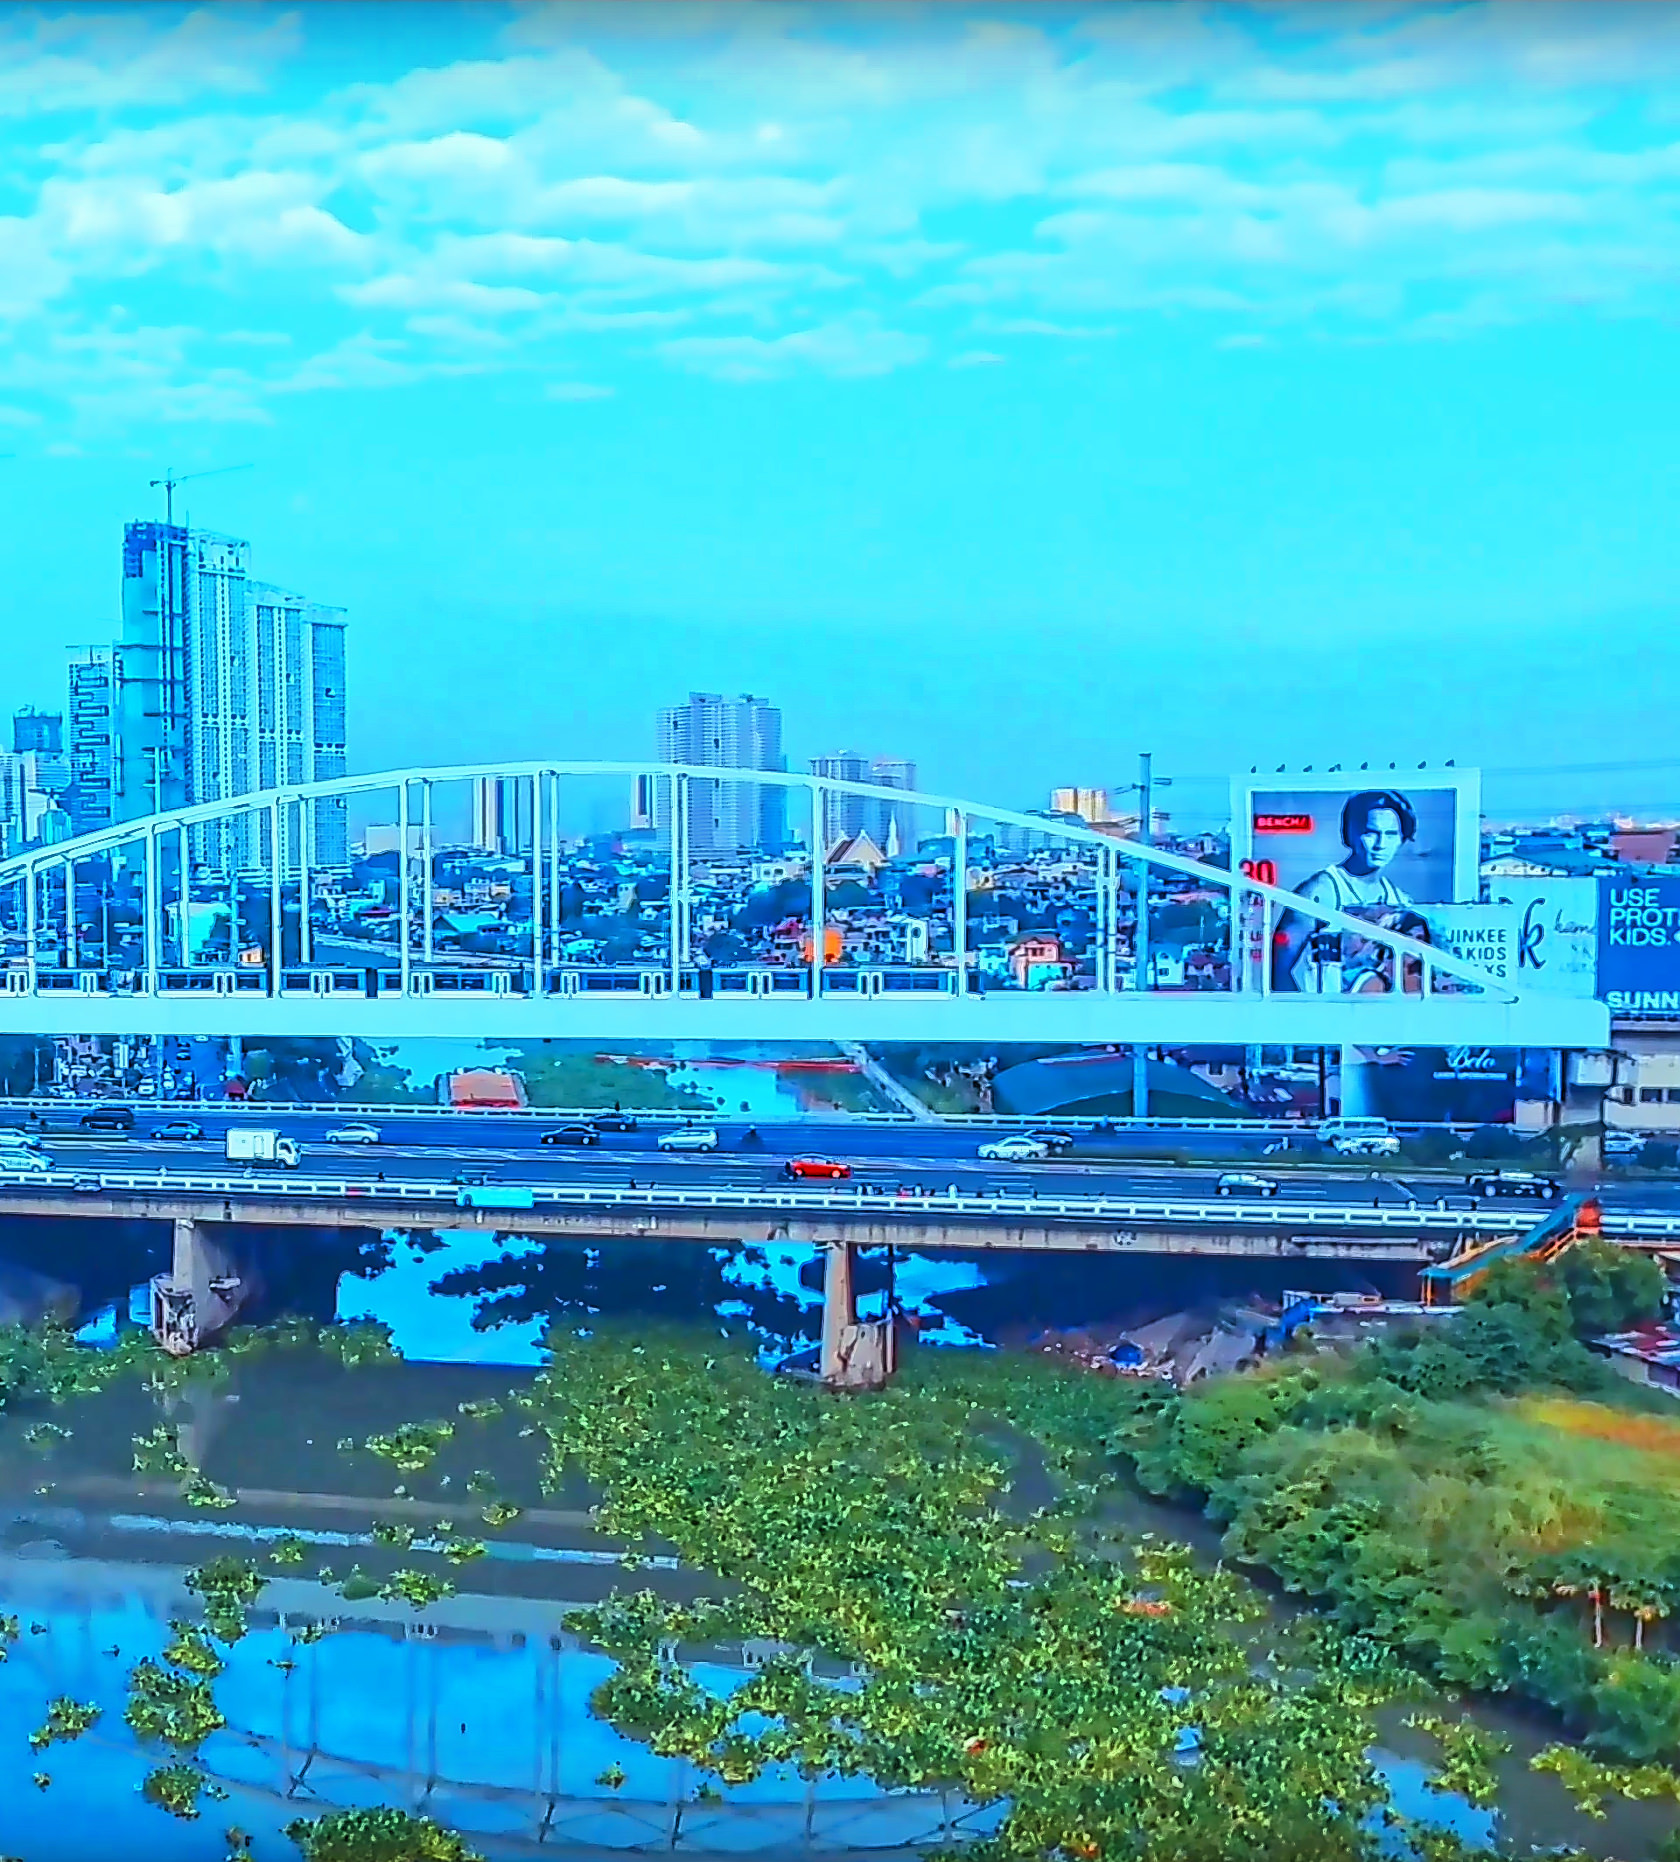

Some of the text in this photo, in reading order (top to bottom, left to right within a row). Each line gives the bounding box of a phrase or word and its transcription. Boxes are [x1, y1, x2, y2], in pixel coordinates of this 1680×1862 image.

[1610, 887, 1661, 907] USE
[1610, 907, 1680, 927] PROT
[1446, 928, 1507, 943] JINKEE
[1609, 926, 1672, 946] KIDS.
[1466, 946, 1507, 961] KIDS
